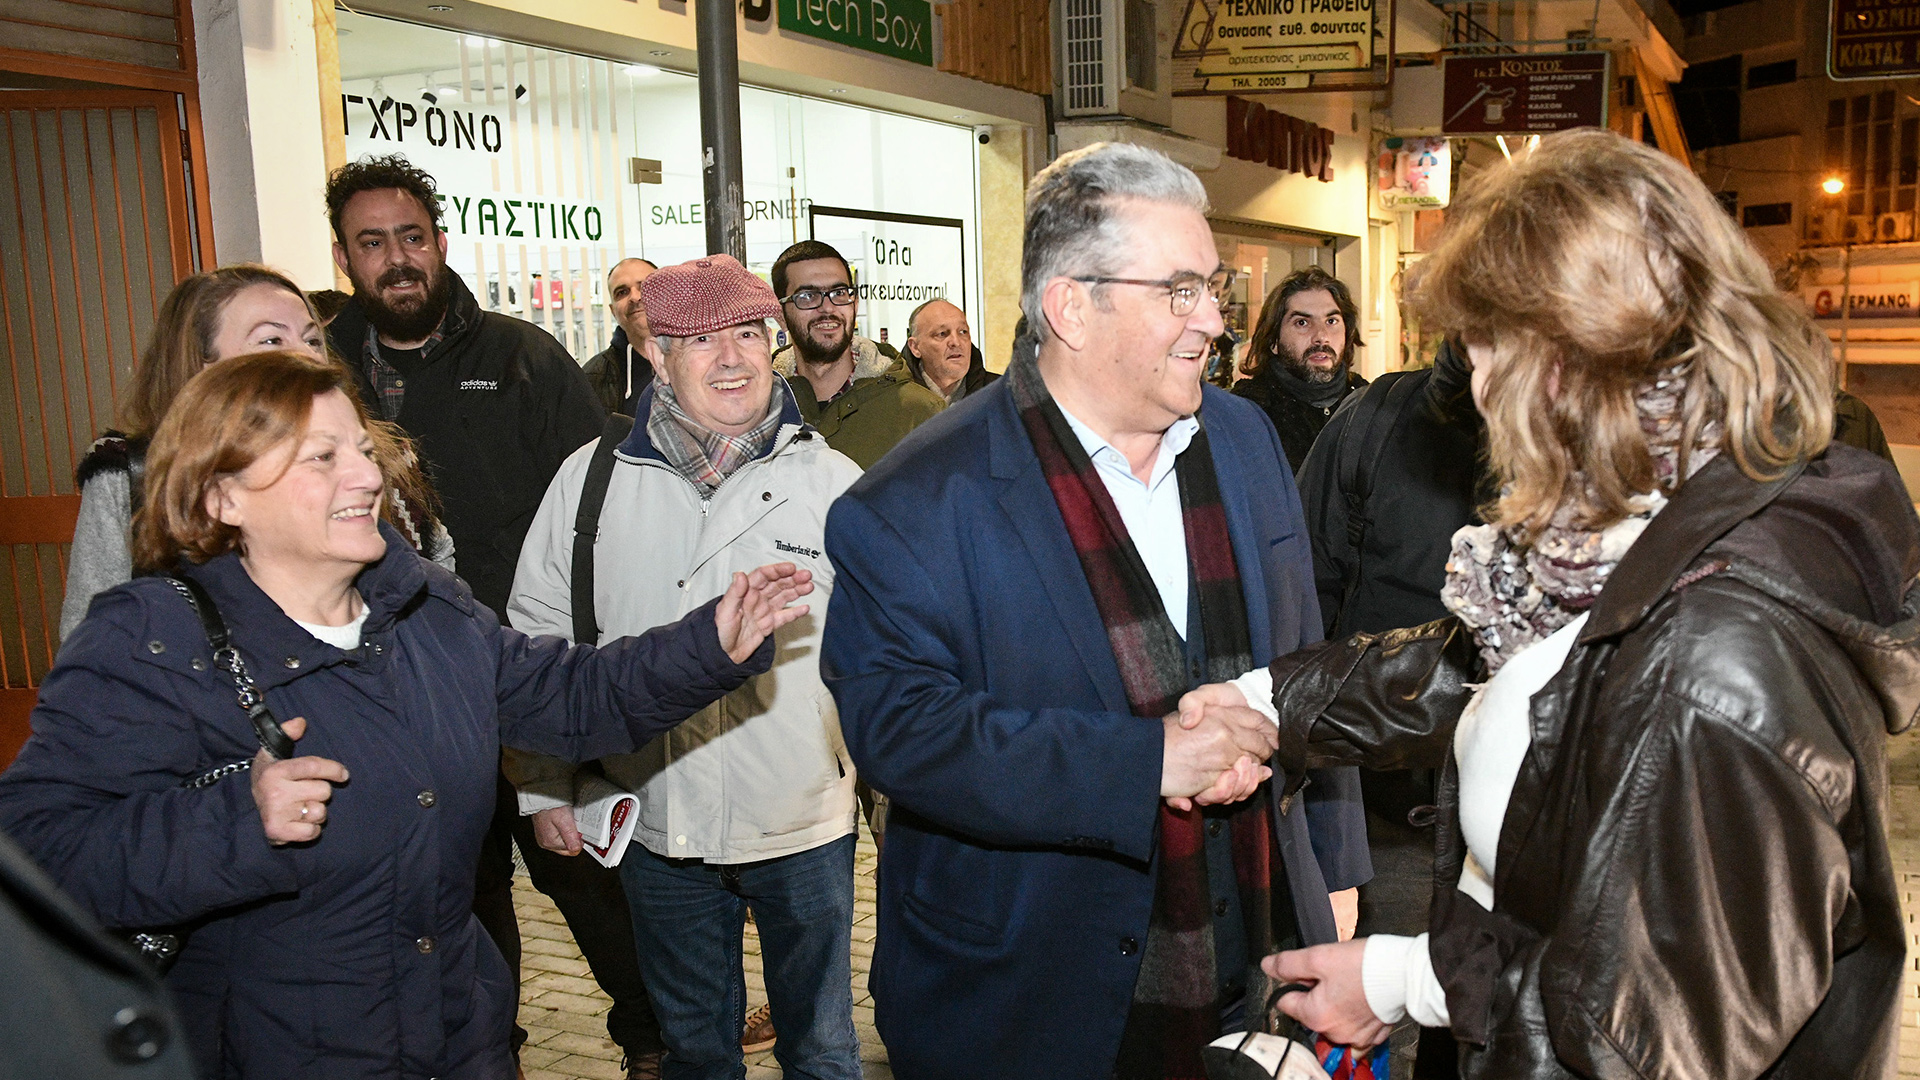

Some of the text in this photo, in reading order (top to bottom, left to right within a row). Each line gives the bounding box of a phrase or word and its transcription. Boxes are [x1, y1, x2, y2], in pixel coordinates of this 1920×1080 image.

[872, 0, 922, 53] Box
[1310, 21, 1366, 34] Φουντας
[1840, 41, 1904, 67] ΚΩΣΤΑΣ
[1258, 76, 1286, 87] 20003
[341, 93, 502, 153] ΓΧΡΟΝΟ
[743, 198, 813, 221] ORNER
[872, 236, 912, 266] Όλα
[859, 278, 948, 301] σκευάζονται!
[775, 540, 811, 556] Timberland
